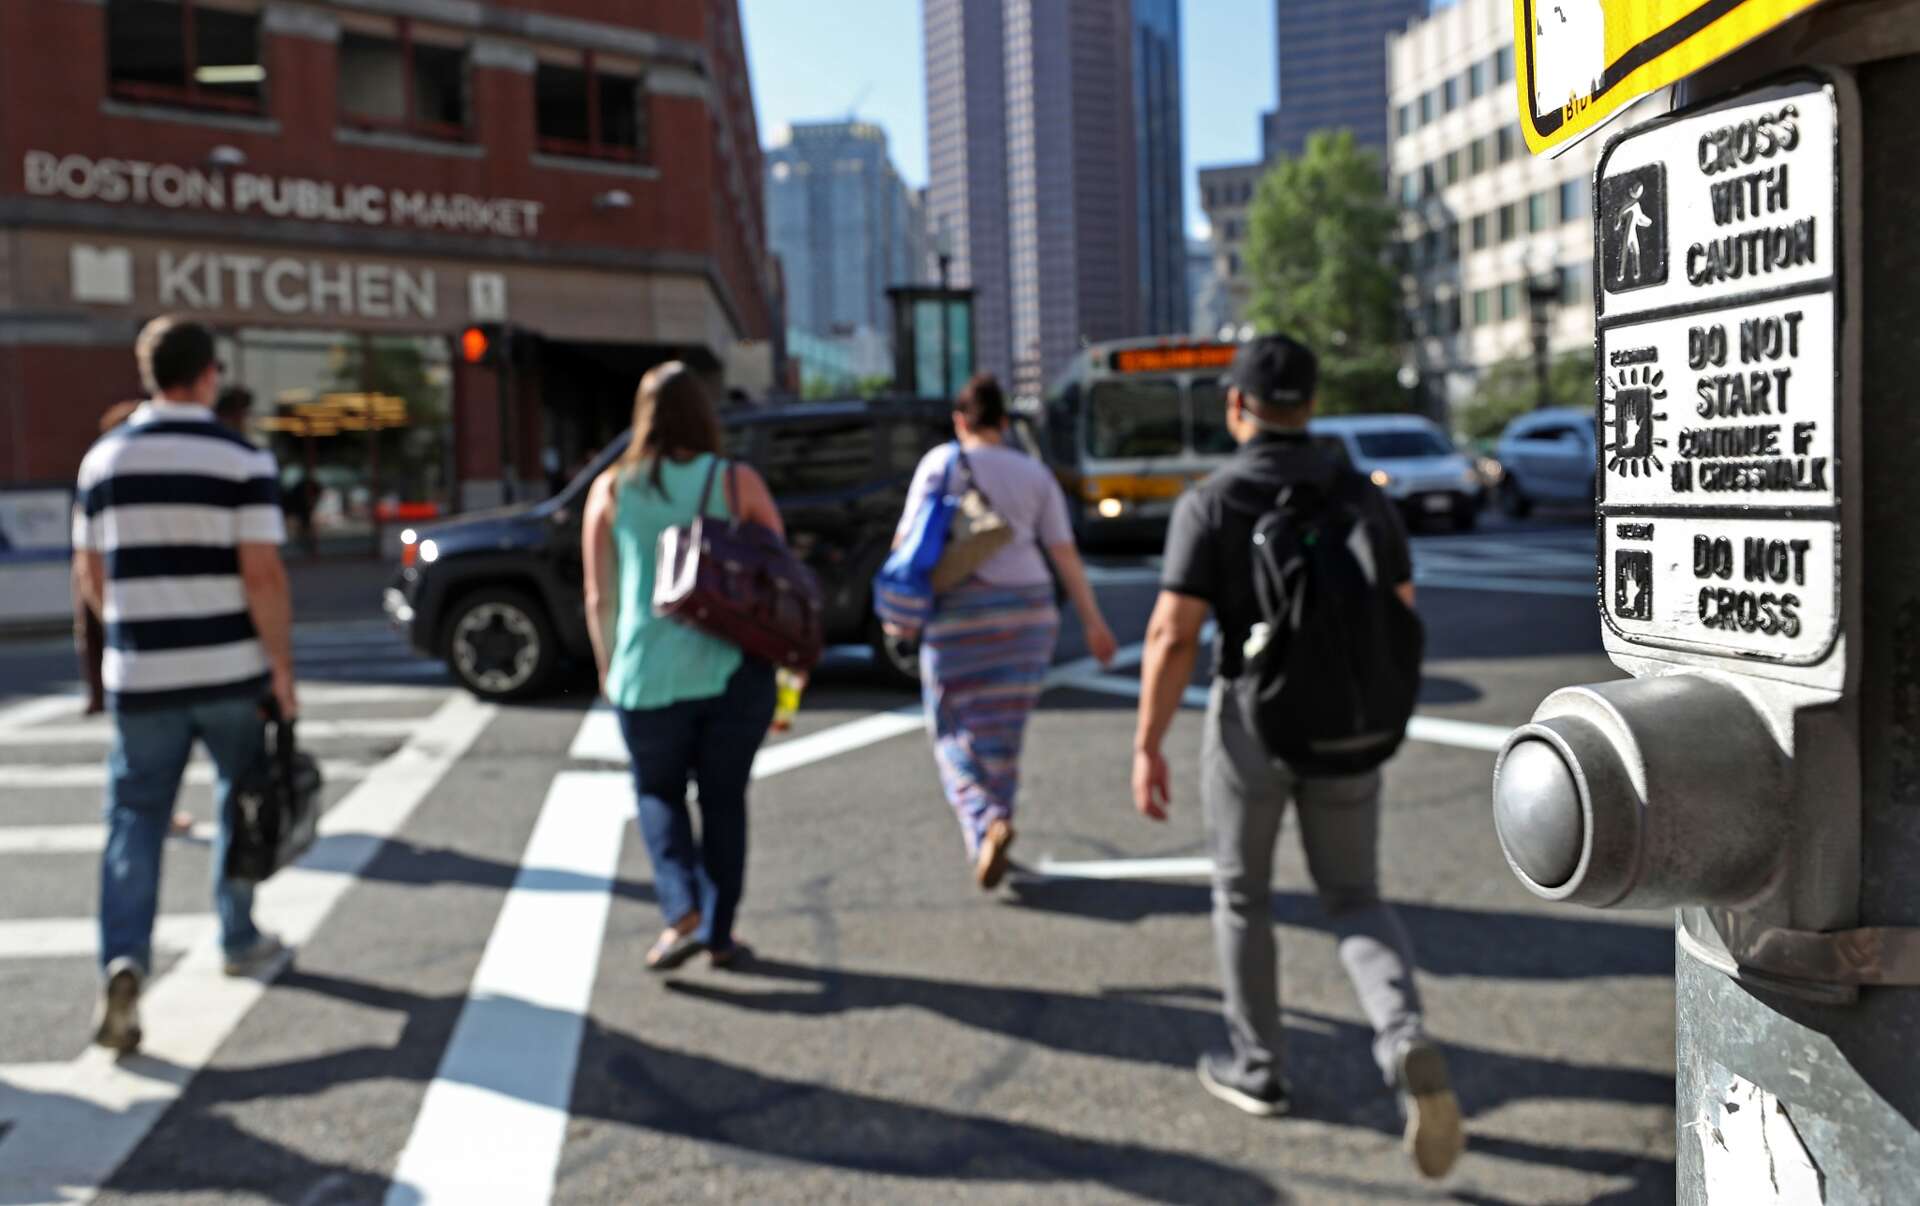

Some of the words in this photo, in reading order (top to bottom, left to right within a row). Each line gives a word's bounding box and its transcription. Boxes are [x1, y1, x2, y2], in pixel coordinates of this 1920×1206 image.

[1698, 104, 1799, 175] CROSS
[24, 150, 226, 210] BOSTON
[231, 172, 386, 225] PUBLIC
[390, 188, 544, 238] MARKET
[1710, 164, 1788, 226] WITH
[1686, 215, 1815, 286] CAUTION
[158, 250, 437, 320] KITCHEN
[1688, 323, 1727, 370] DO
[1740, 311, 1803, 364] NOT
[1696, 368, 1792, 419] START
[1693, 534, 1733, 580] DO
[1744, 536, 1811, 586] NOT
[1698, 586, 1801, 638] CROSS
